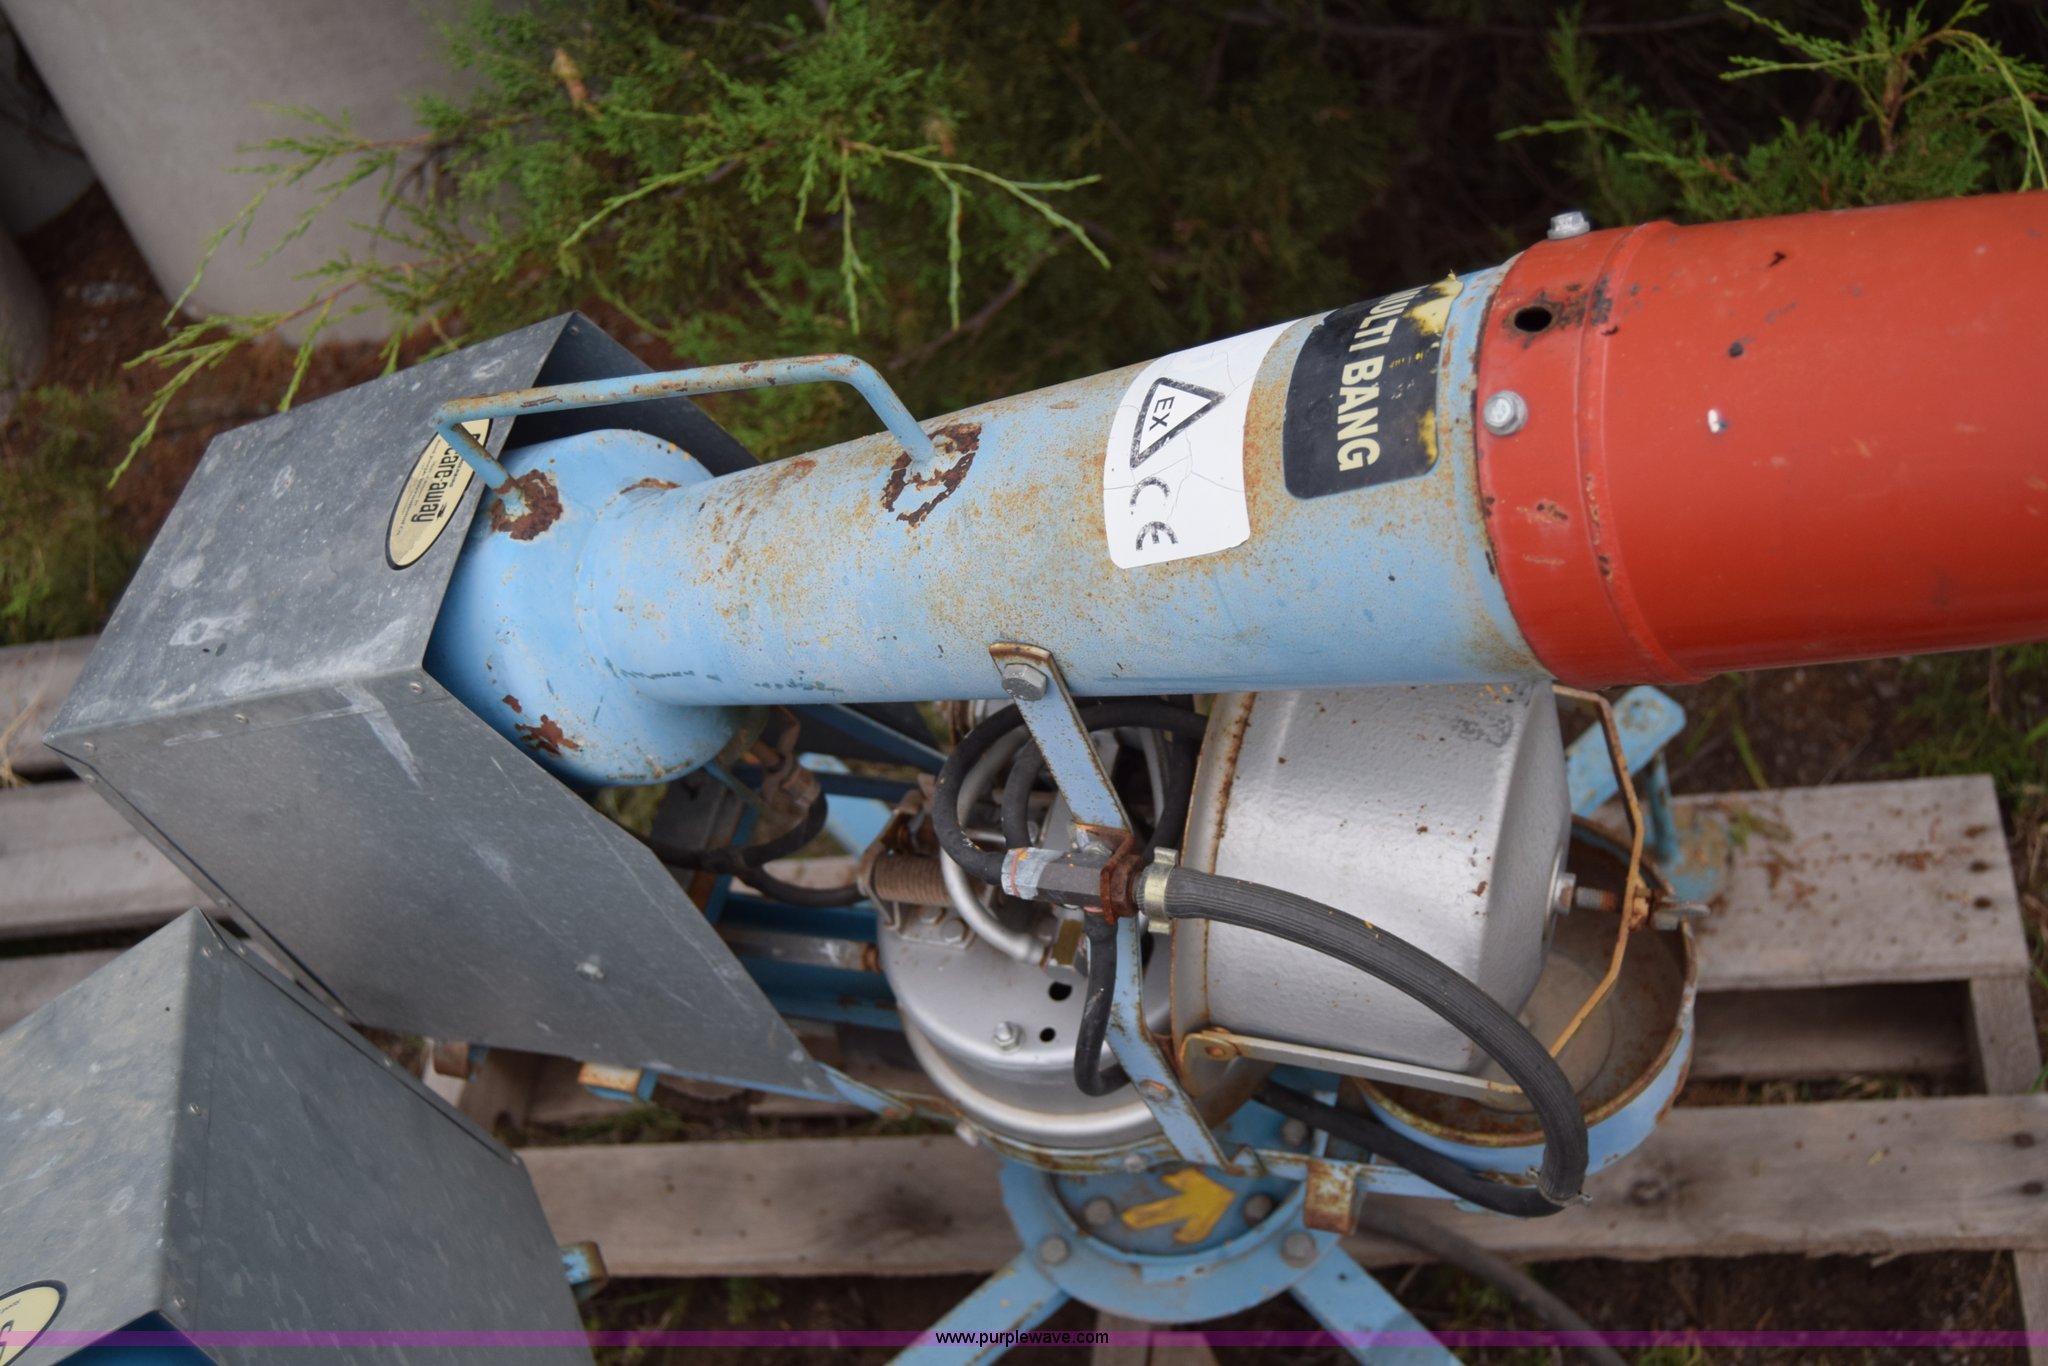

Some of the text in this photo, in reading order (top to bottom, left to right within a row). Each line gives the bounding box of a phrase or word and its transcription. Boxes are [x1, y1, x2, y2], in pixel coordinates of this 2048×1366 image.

[1149, 396, 1175, 431] EX
[1336, 355, 1382, 472] BANG
[411, 447, 460, 523] care-away
[1130, 476, 1178, 551] CE
